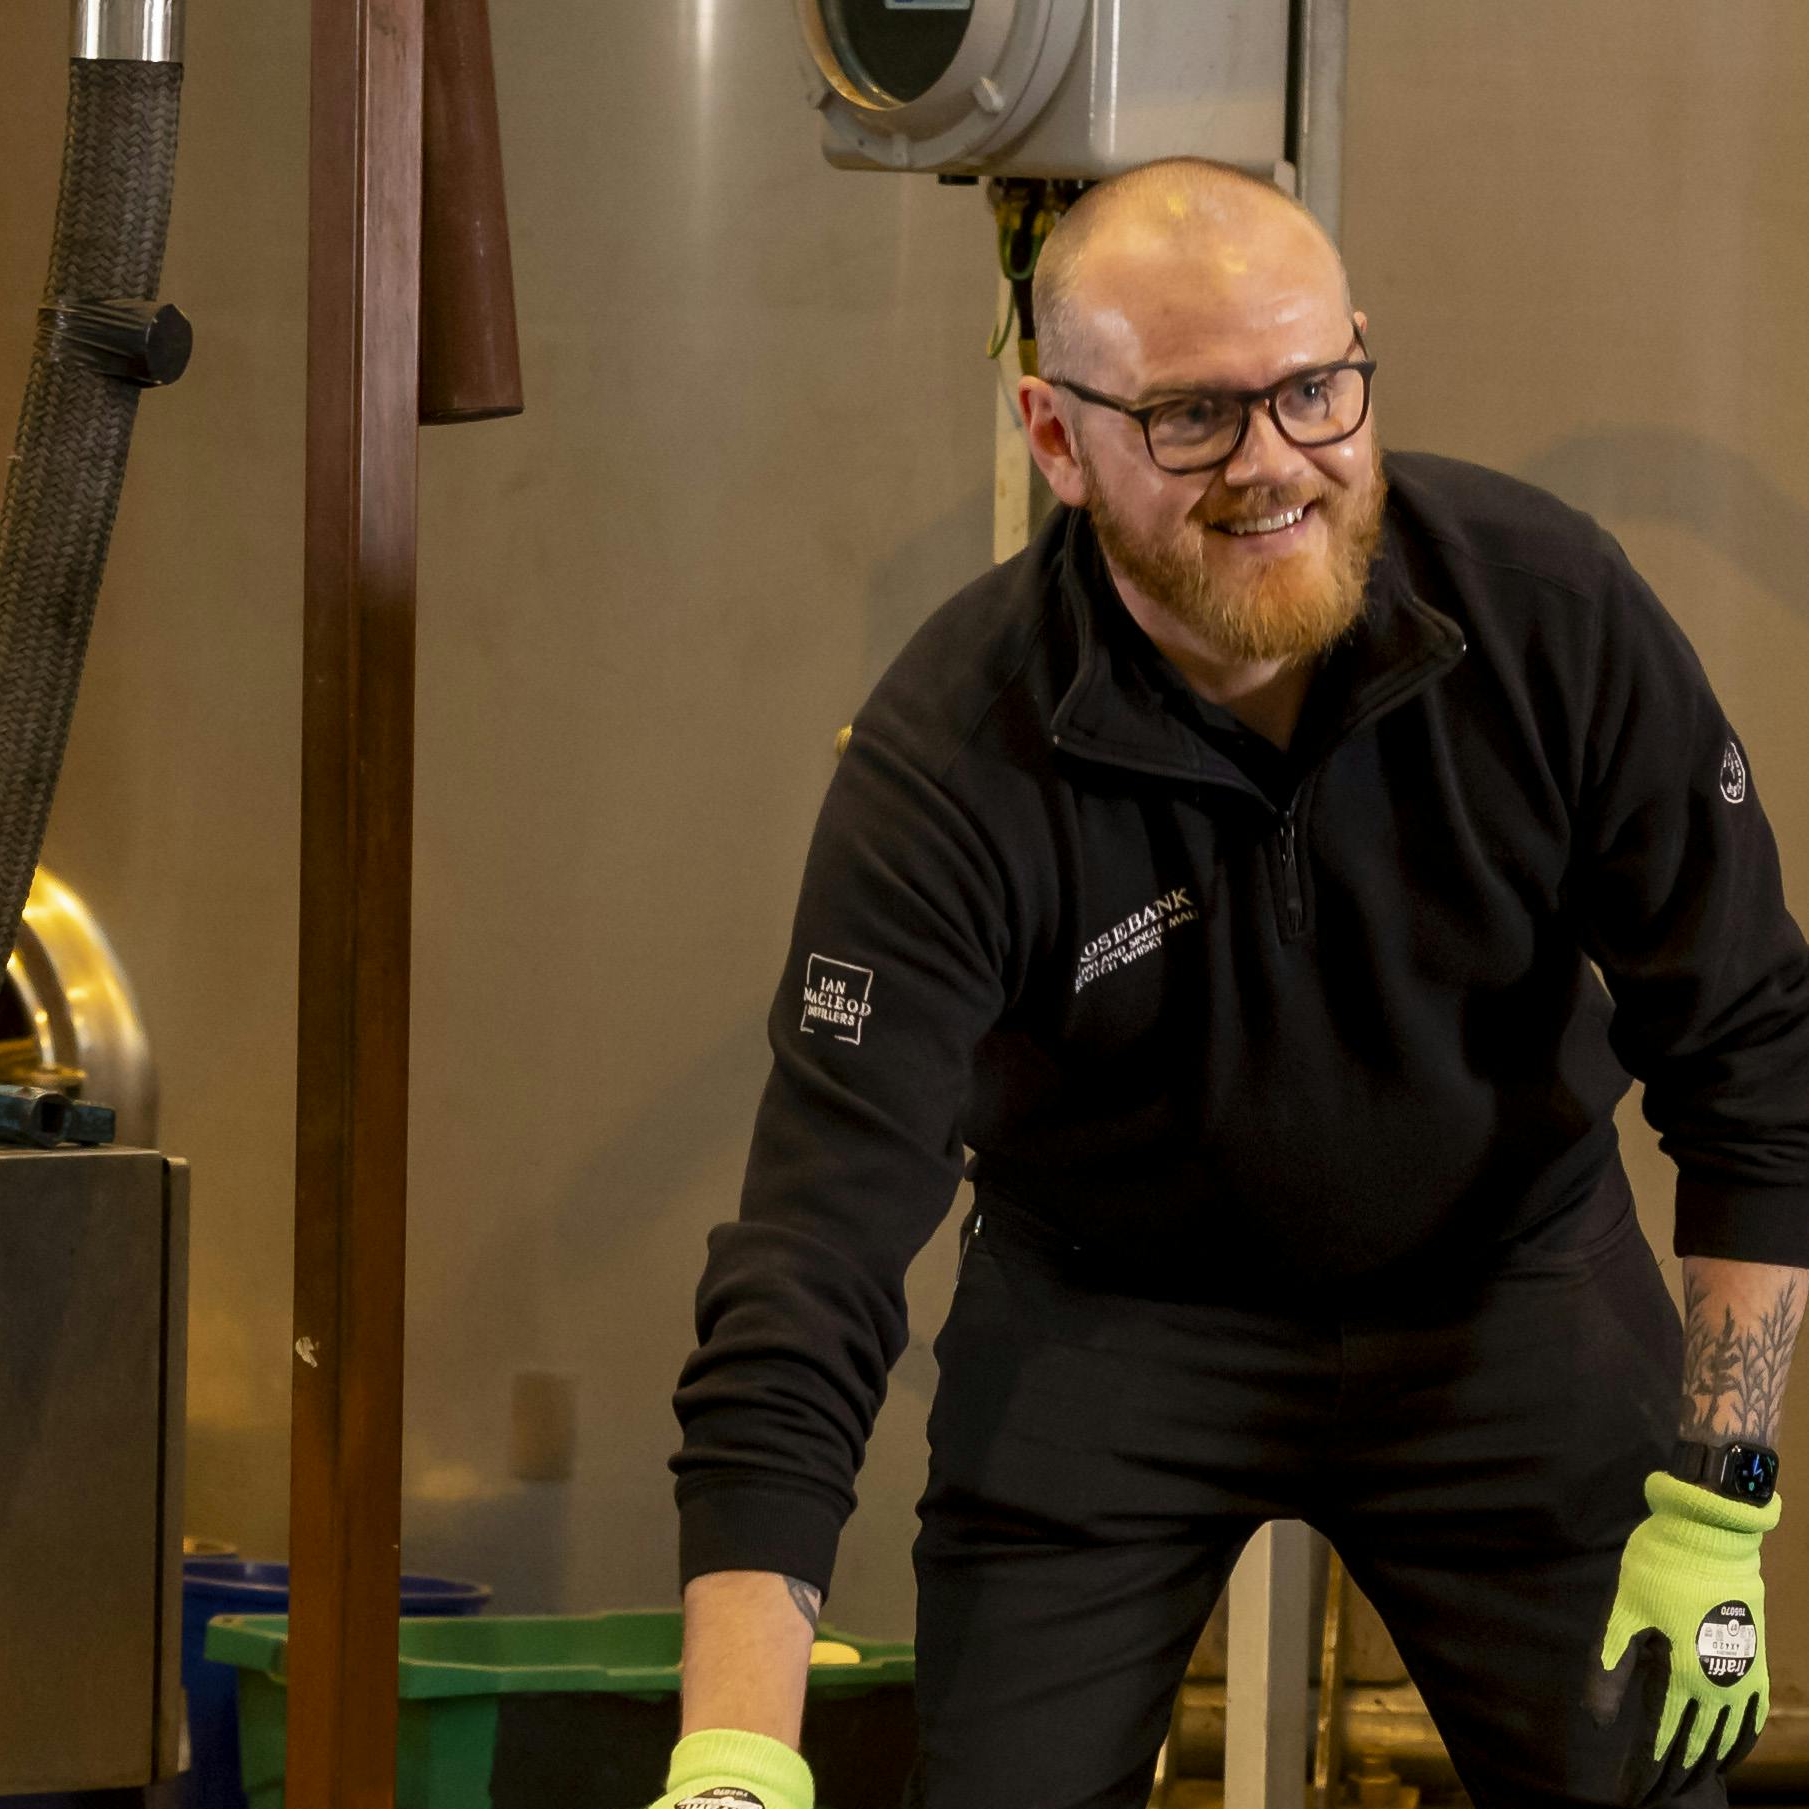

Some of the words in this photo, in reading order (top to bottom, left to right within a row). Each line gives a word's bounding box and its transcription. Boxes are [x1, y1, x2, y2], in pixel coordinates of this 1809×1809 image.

[1080, 887, 1194, 962] OSEBANK
[820, 976, 847, 995] IAN
[803, 986, 872, 1017] MACLEOD
